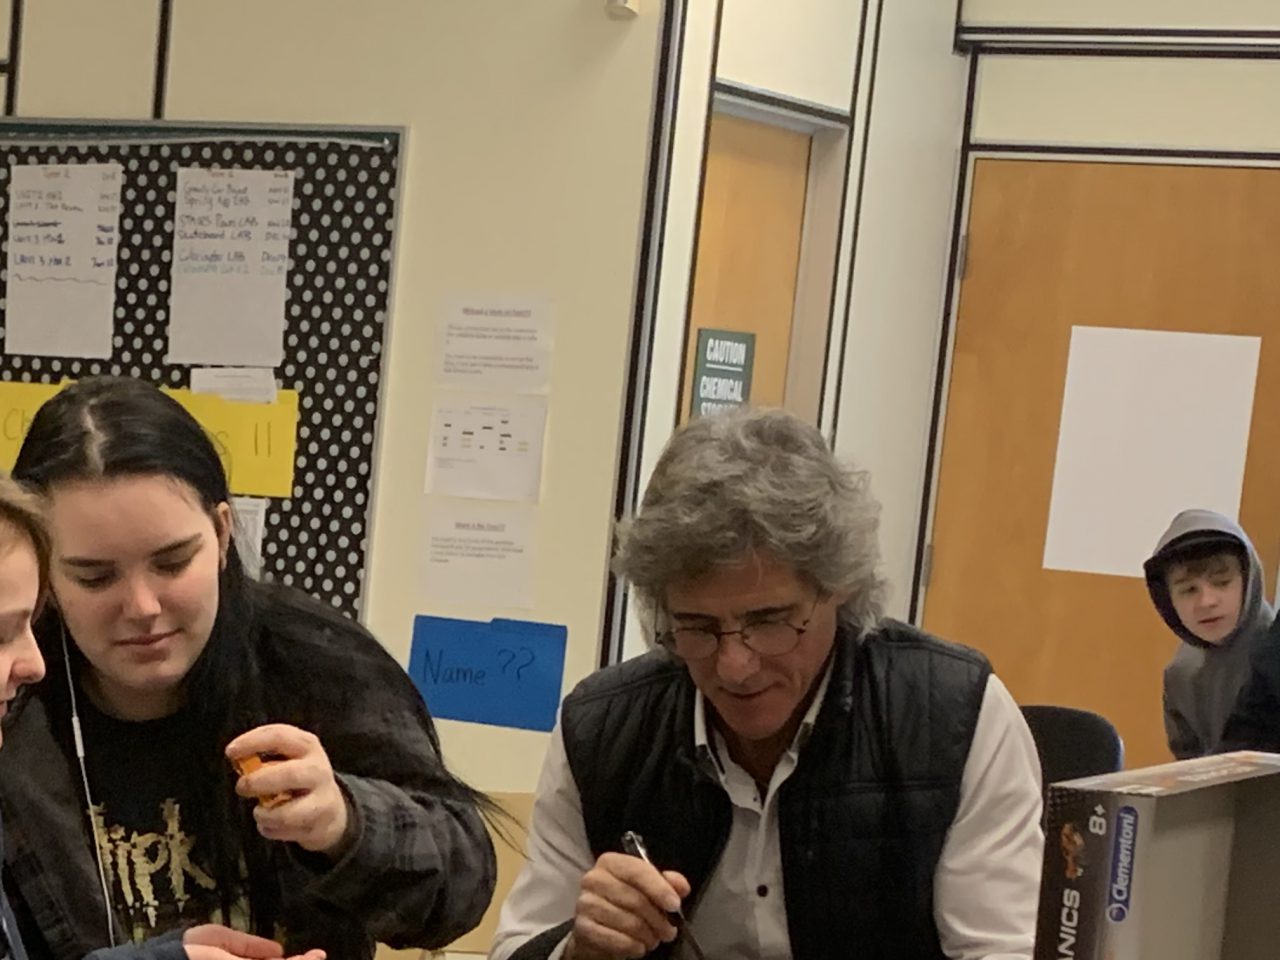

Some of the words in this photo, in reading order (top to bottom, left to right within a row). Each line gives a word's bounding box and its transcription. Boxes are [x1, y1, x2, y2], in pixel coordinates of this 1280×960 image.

[705, 337, 746, 366] CAUTION
[699, 375, 743, 402] CHEMICAL
[423, 648, 486, 686] Name
[1088, 803, 1108, 836] 8+
[1111, 813, 1136, 901] Clementoni
